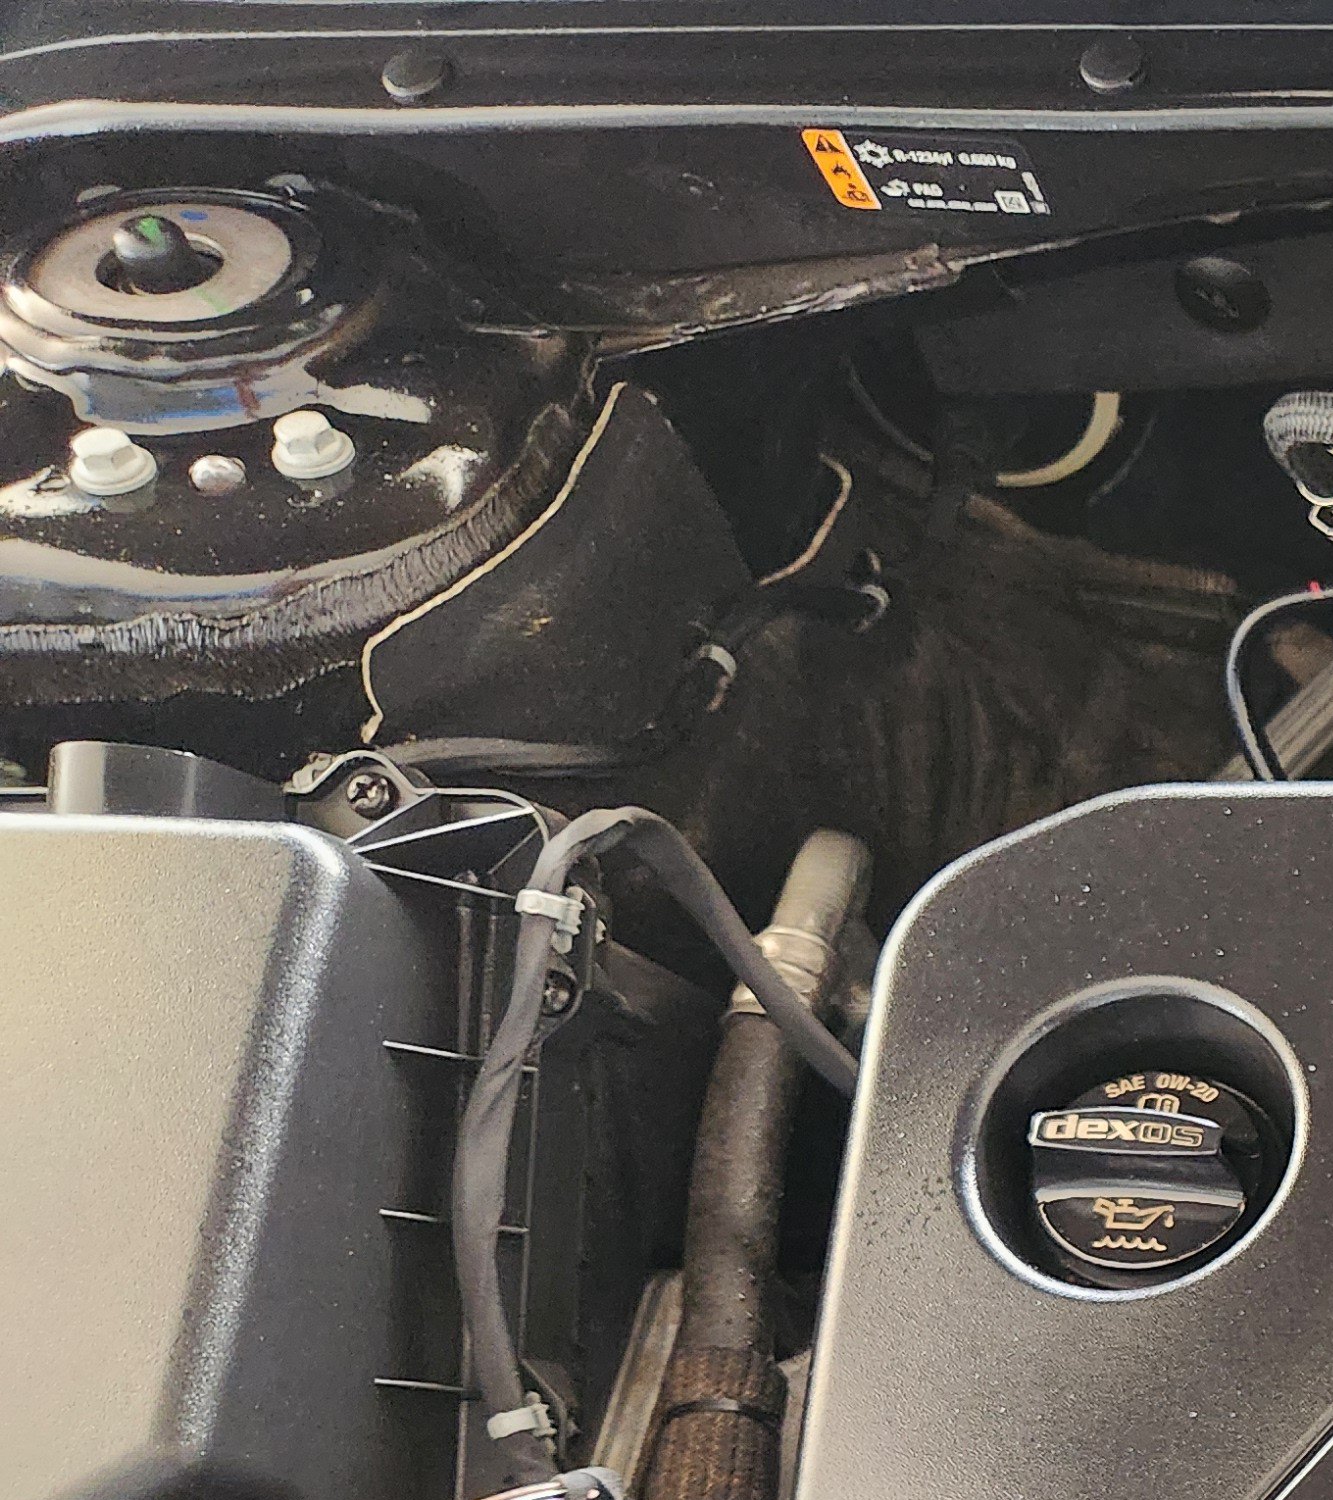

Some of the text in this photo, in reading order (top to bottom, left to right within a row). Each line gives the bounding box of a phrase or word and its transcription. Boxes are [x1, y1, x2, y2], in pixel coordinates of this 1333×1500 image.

[1105, 1073, 1220, 1103] SAE 0W-20
[1043, 1114, 1205, 1148] dexos
